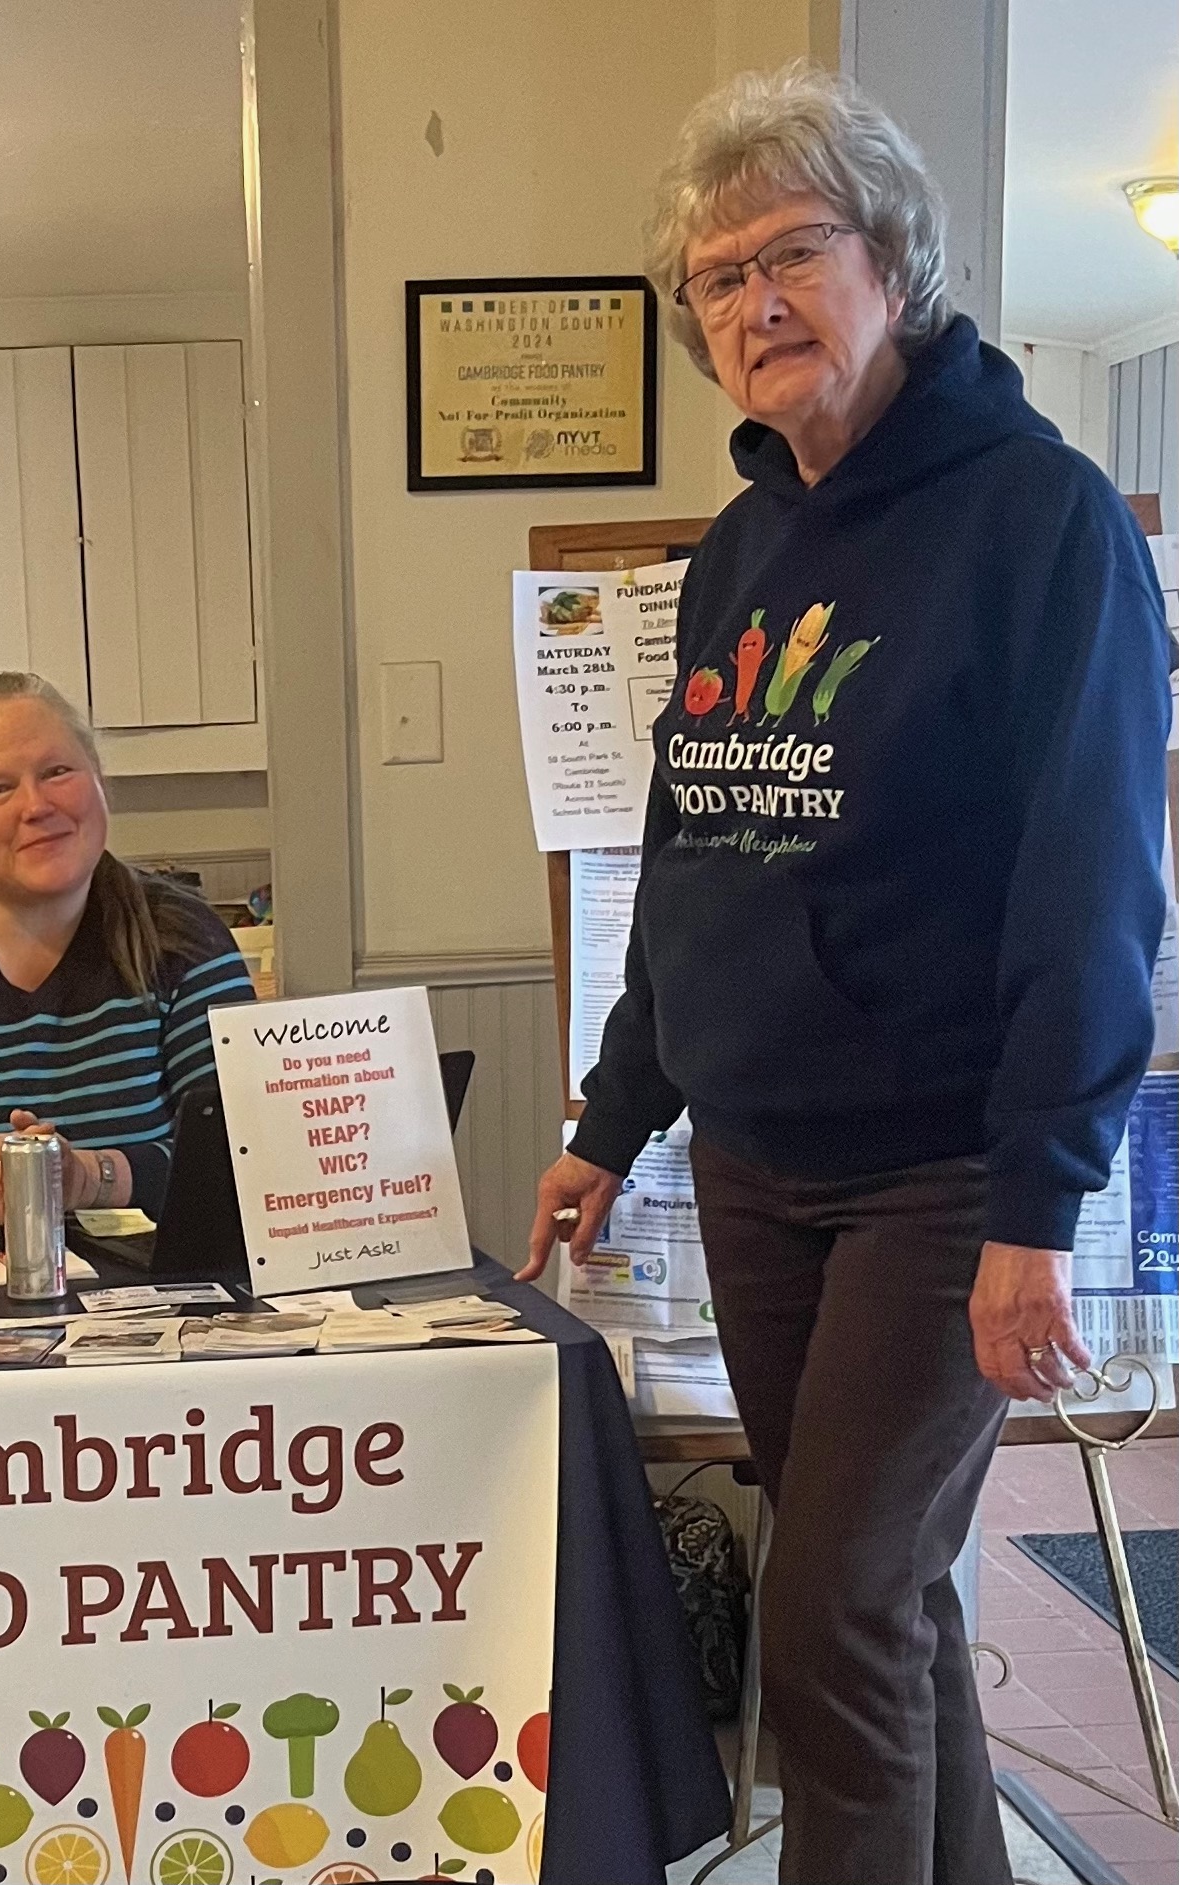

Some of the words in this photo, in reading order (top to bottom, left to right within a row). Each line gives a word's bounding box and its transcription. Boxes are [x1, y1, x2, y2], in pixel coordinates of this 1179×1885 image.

[498, 300, 537, 315] BEST
[549, 299, 566, 314] OF
[439, 317, 550, 333] WASHINGTON
[560, 315, 625, 331] COUNTY
[512, 334, 553, 349] 2024
[457, 364, 525, 381] CAMBRIDGE
[528, 364, 559, 380] FOOD
[561, 363, 606, 380] PANTRY
[491, 394, 568, 408] Community
[466, 411, 490, 421] For
[495, 408, 533, 421] Profit
[537, 407, 626, 422] Organization
[537, 646, 611, 660] SATURDAY
[637, 650, 670, 663] Food
[537, 664, 579, 676] March
[583, 662, 616, 674] 28th
[545, 683, 576, 695] 4:30
[580, 684, 611, 696] p.m.
[570, 702, 589, 713] To
[551, 722, 582, 733] 6:00
[586, 722, 617, 734] p.m.
[588, 752, 609, 760] Park
[668, 733, 835, 782] Cambridge
[728, 784, 846, 820] PANTRY
[253, 1013, 391, 1047] Welcome
[282, 1055, 302, 1072] Do
[306, 1054, 333, 1072] you
[336, 1048, 372, 1066] need
[265, 1072, 350, 1094] information
[354, 1065, 396, 1083] about
[301, 1093, 367, 1119] SNAP?
[307, 1122, 372, 1148] HEAP?
[318, 1151, 369, 1176] WIC?
[264, 1183, 375, 1213] Emergency
[379, 1172, 433, 1198] Fuel?
[642, 1196, 697, 1212] Require
[267, 1222, 309, 1240] Unpaid
[311, 1215, 375, 1233] Healthcare
[377, 1205, 439, 1226] Expenses?
[308, 1247, 353, 1270] Just
[356, 1239, 402, 1261] Ask!
[59, 1540, 484, 1648] PANTRY
